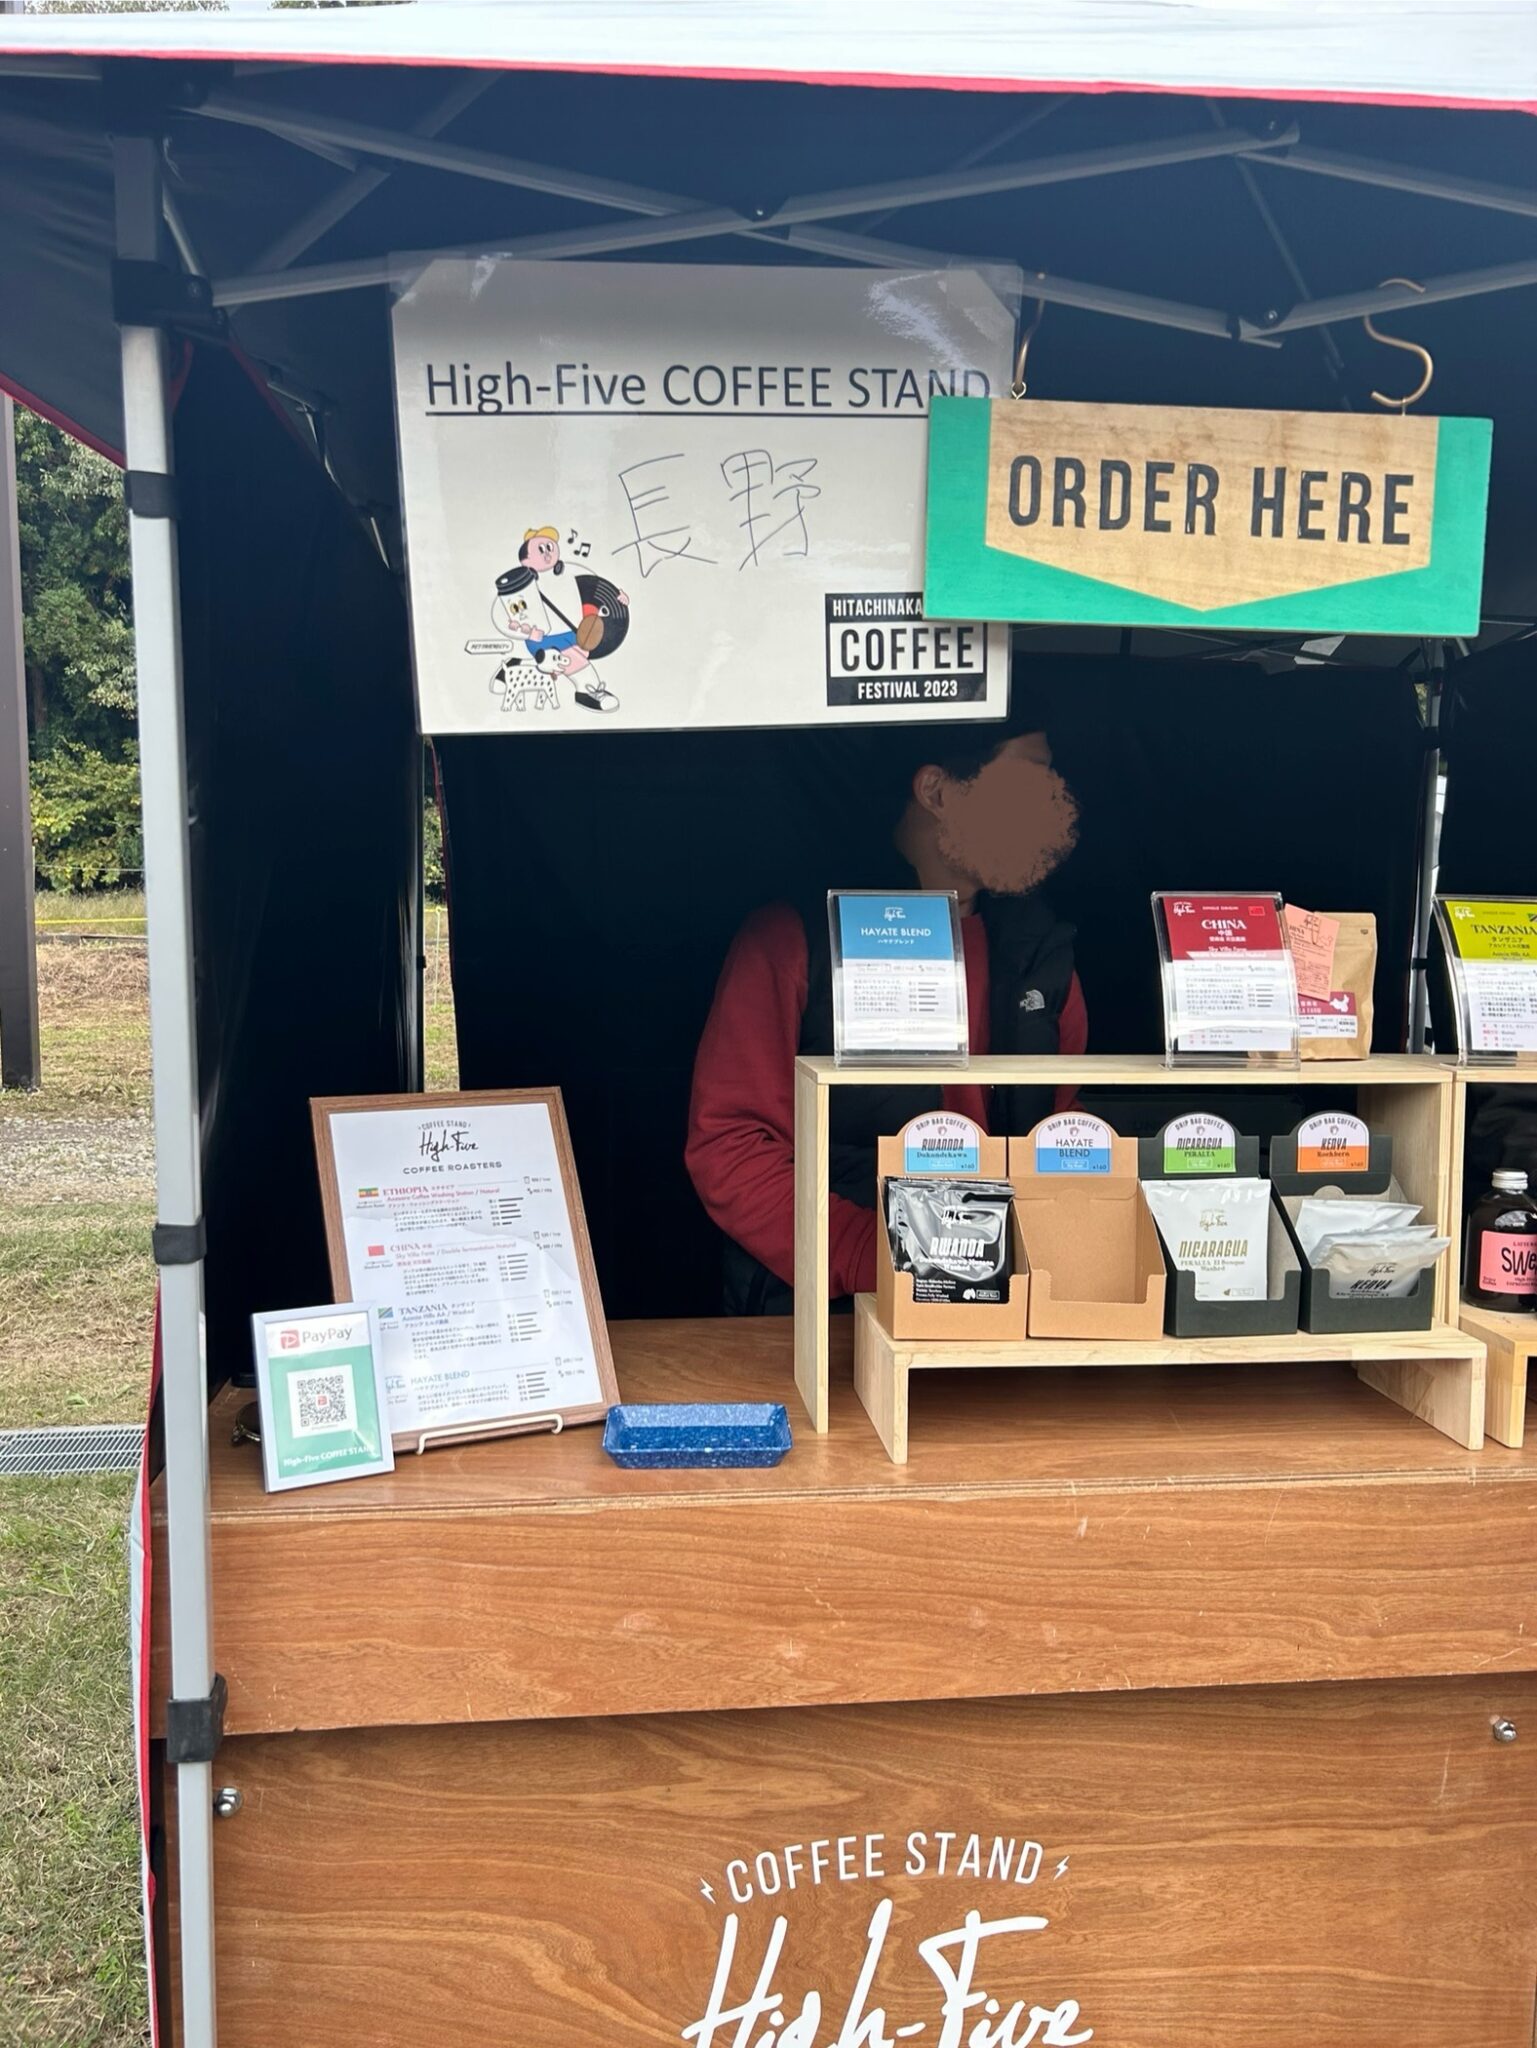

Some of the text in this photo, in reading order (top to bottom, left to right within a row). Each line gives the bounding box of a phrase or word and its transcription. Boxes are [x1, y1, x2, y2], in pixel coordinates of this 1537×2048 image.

[427, 363, 991, 413] High-Five COFFEE STAND
[1008, 455, 1414, 546] ORDER HERE
[833, 598, 922, 616] HITACHINAKA
[840, 627, 974, 672] COFFEE
[858, 680, 958, 699] FESTIVAL 2023
[1201, 919, 1247, 929] CHINA
[1471, 924, 1537, 935] TANZANIA
[860, 927, 932, 937] HAYATE BLEND
[421, 1119, 469, 1130] COFFEE STAND
[945, 1118, 968, 1131] COFFEE
[1077, 1118, 1100, 1132] COFFEE
[1203, 1118, 1225, 1130] COFFEE
[1337, 1117, 1358, 1130] COFFEE
[420, 1130, 479, 1162] High-Five
[1055, 1138, 1094, 1147] HAYATE
[1176, 1137, 1222, 1150] NICARAGUA
[1320, 1137, 1347, 1150] KENYA
[1059, 1149, 1091, 1157] BLEND
[403, 1161, 503, 1175] COFFEE ROASTERS
[383, 1186, 429, 1196] ETHIOPIA
[390, 1243, 420, 1252] CHINA
[929, 1237, 985, 1257] RWANDA
[1179, 1240, 1248, 1258] NICARAGUA
[1501, 1246, 1537, 1275] Swe
[1350, 1280, 1393, 1290] KENYA
[399, 1304, 448, 1315] TANZANIA
[302, 1327, 353, 1343] PayPay
[410, 1374, 443, 1384] HAYATE
[444, 1370, 470, 1379] BLEND
[726, 1831, 1044, 1903] COFFEE STAND
